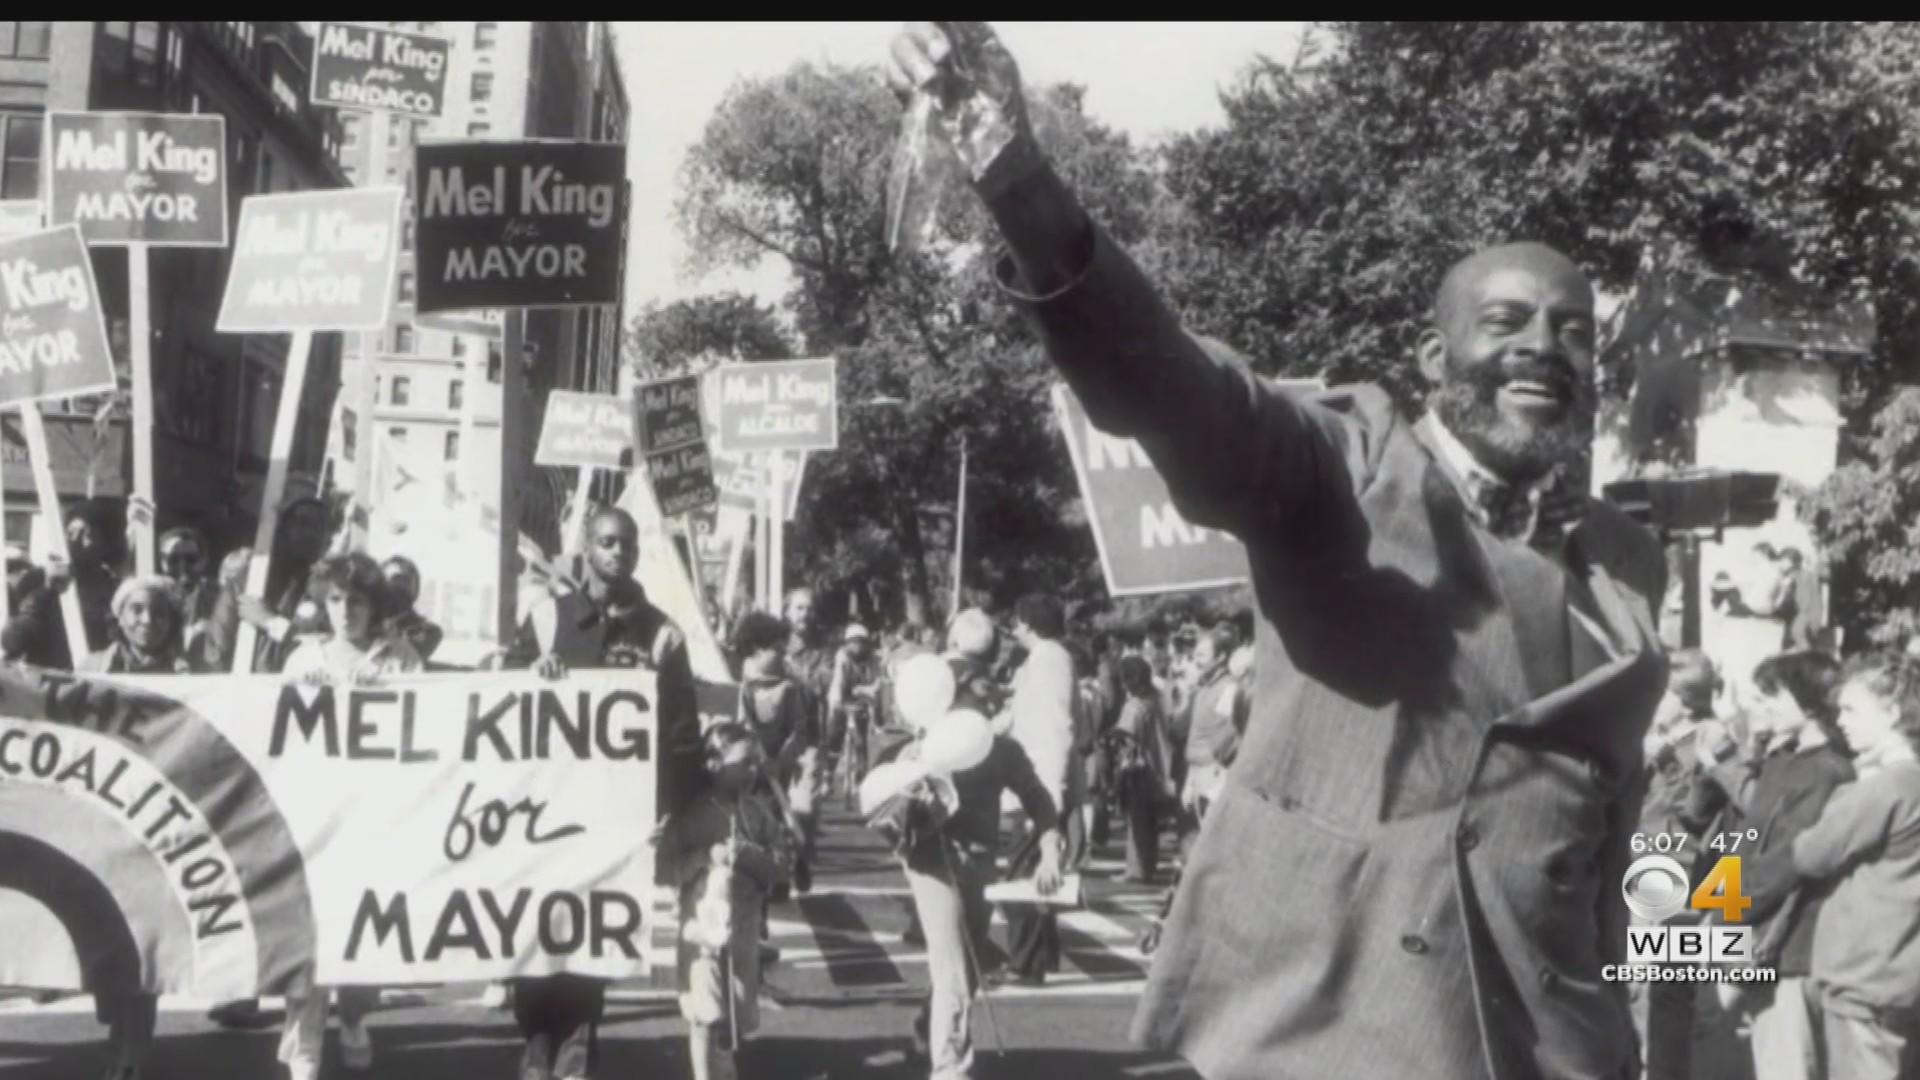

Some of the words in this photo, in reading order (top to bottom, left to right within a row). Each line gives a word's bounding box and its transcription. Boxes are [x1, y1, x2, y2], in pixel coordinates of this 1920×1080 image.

[320, 25, 376, 60] Mel
[382, 33, 445, 81] King
[328, 79, 434, 113] SINDACO
[56, 129, 127, 170] Mel
[136, 131, 217, 185] King
[74, 192, 198, 223] MAYOR
[420, 166, 506, 219] Mel
[519, 164, 615, 228] King
[239, 211, 308, 254] Mel
[315, 208, 389, 262] King
[0, 256, 90, 313] King
[247, 273, 363, 305] MAYOR
[442, 244, 588, 283] MAYOR
[0, 327, 82, 375] AYOR
[724, 374, 769, 404] Mel
[777, 374, 830, 407] King
[40, 673, 150, 745] THE
[268, 684, 439, 764] MEL
[460, 689, 652, 763] KING
[0, 728, 244, 940] COALITION
[442, 781, 587, 864] for
[342, 888, 643, 965] MAYOR
